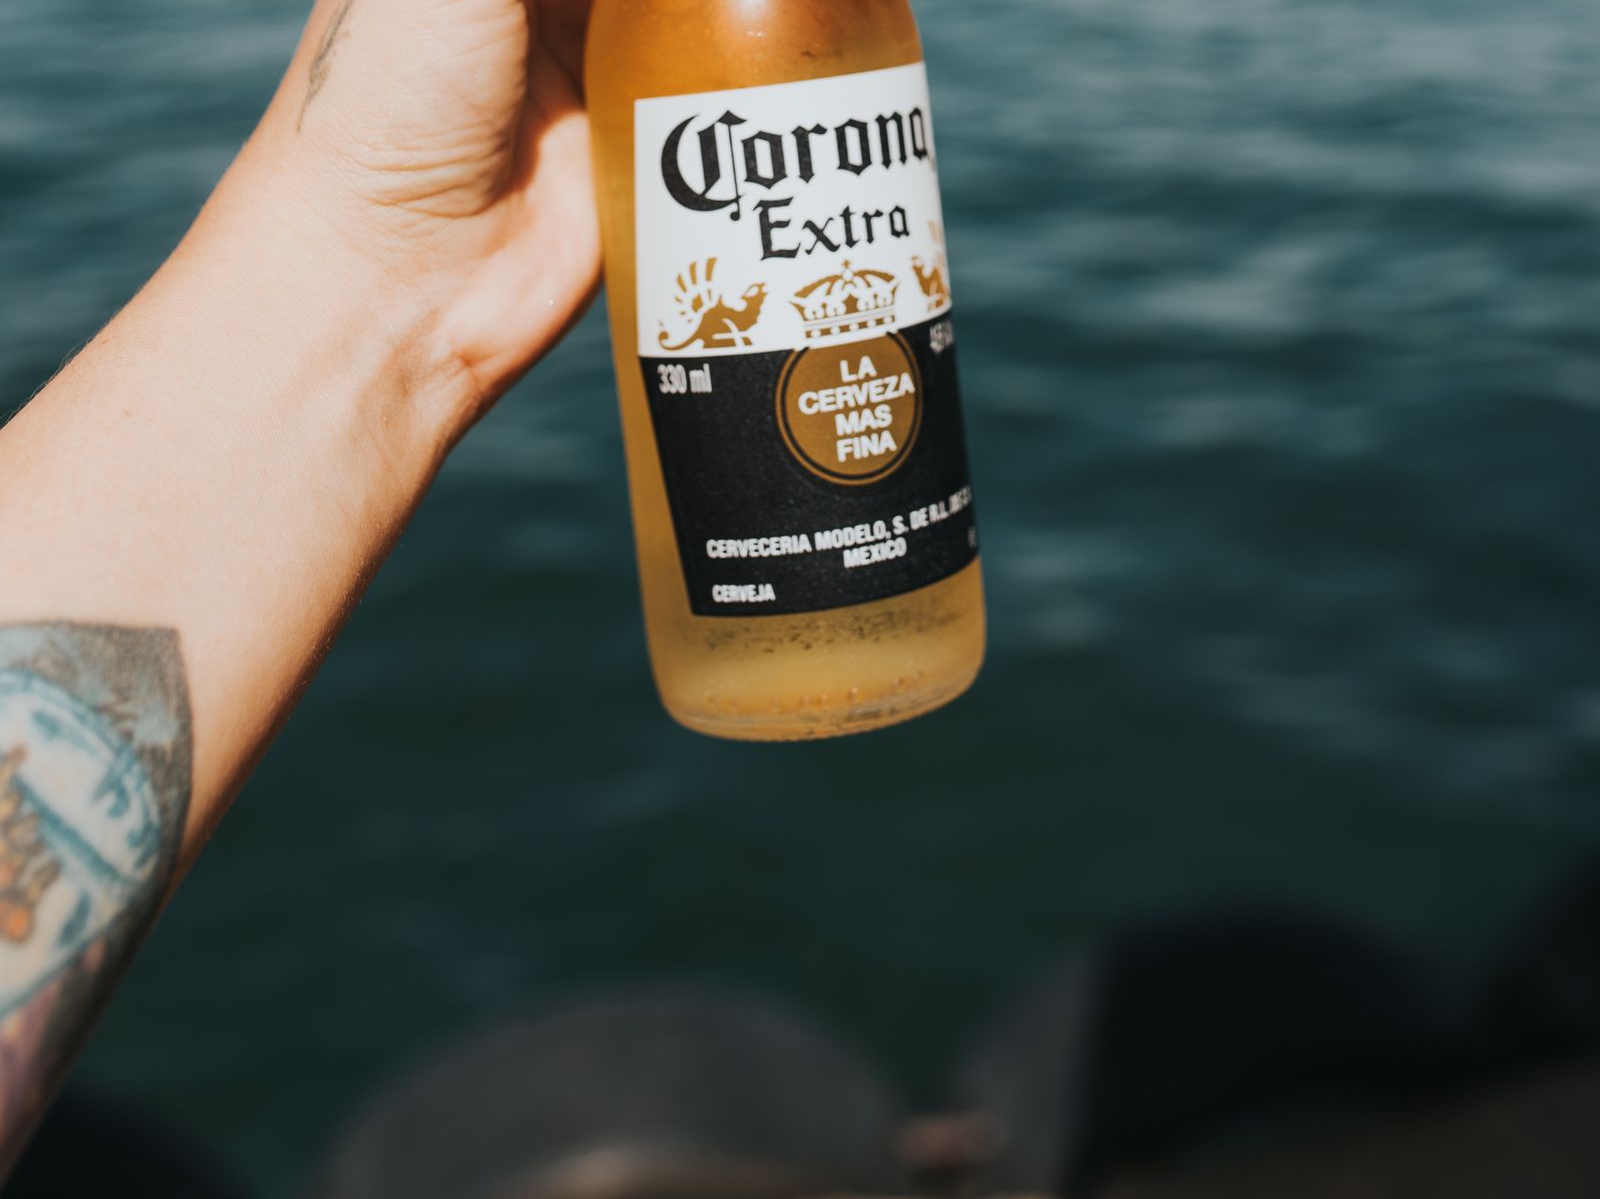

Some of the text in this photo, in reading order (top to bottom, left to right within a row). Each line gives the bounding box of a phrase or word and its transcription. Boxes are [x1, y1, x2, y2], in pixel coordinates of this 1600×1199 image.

[660, 108, 929, 222] Corona
[753, 195, 911, 261] Extra
[657, 363, 712, 394] 330 ml
[839, 355, 878, 383] LA
[798, 371, 916, 415] CERVEZA
[835, 404, 893, 437] MAS
[836, 430, 898, 463] FINA
[706, 533, 813, 559] CERVECERIA
[814, 520, 892, 551] MODELO,
[892, 515, 909, 535] S.
[843, 537, 908, 569] MEXICO
[711, 583, 776, 603] CERVEJA
